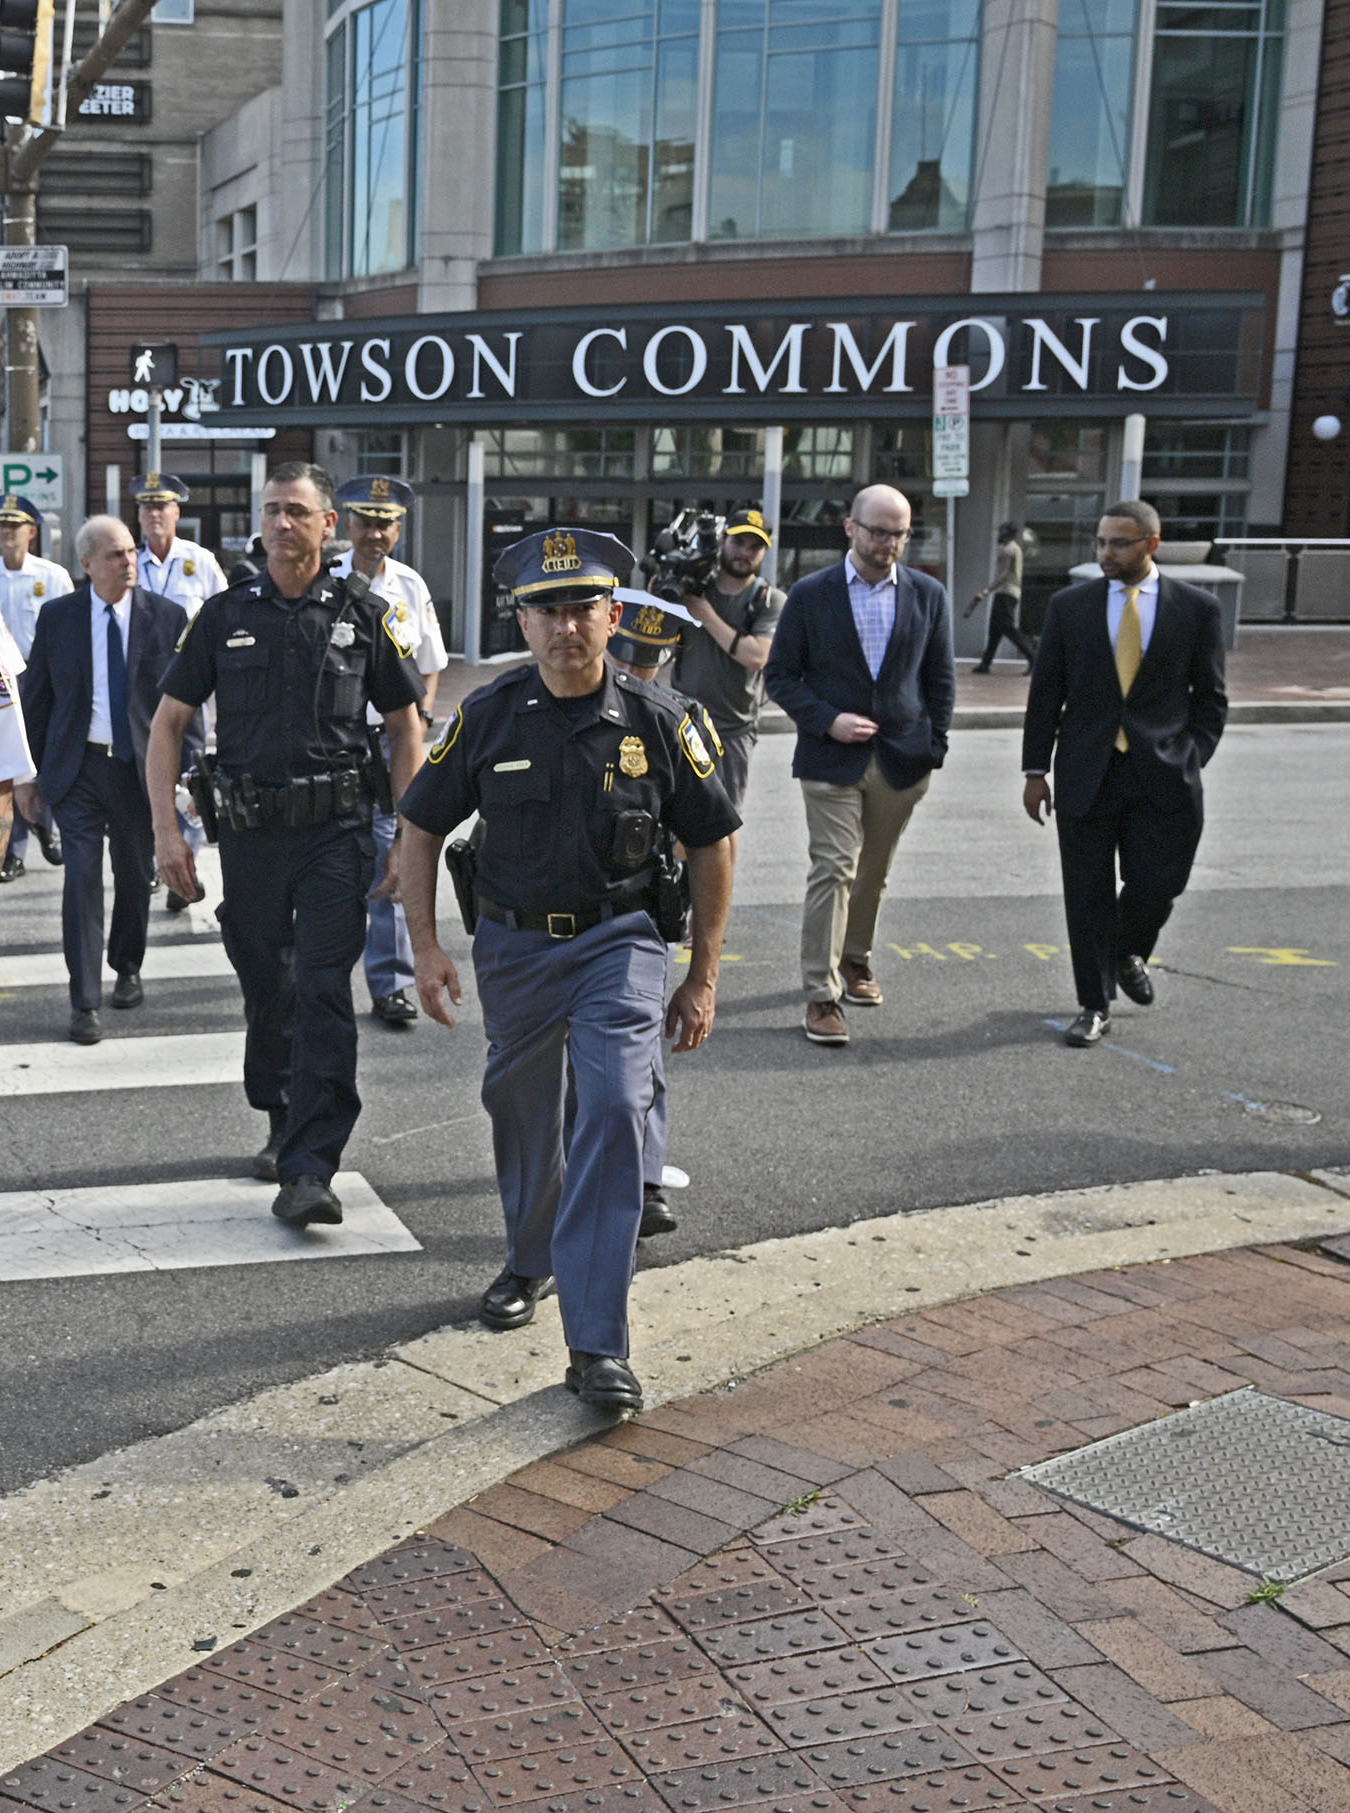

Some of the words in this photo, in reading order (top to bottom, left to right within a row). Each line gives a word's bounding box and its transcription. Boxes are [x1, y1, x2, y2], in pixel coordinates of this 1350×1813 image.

[90, 84, 135, 100] ZIER
[78, 98, 135, 115] EETER
[225, 332, 524, 406] TOWSON
[571, 315, 1170, 398] COMMONS
[3, 464, 32, 494] P
